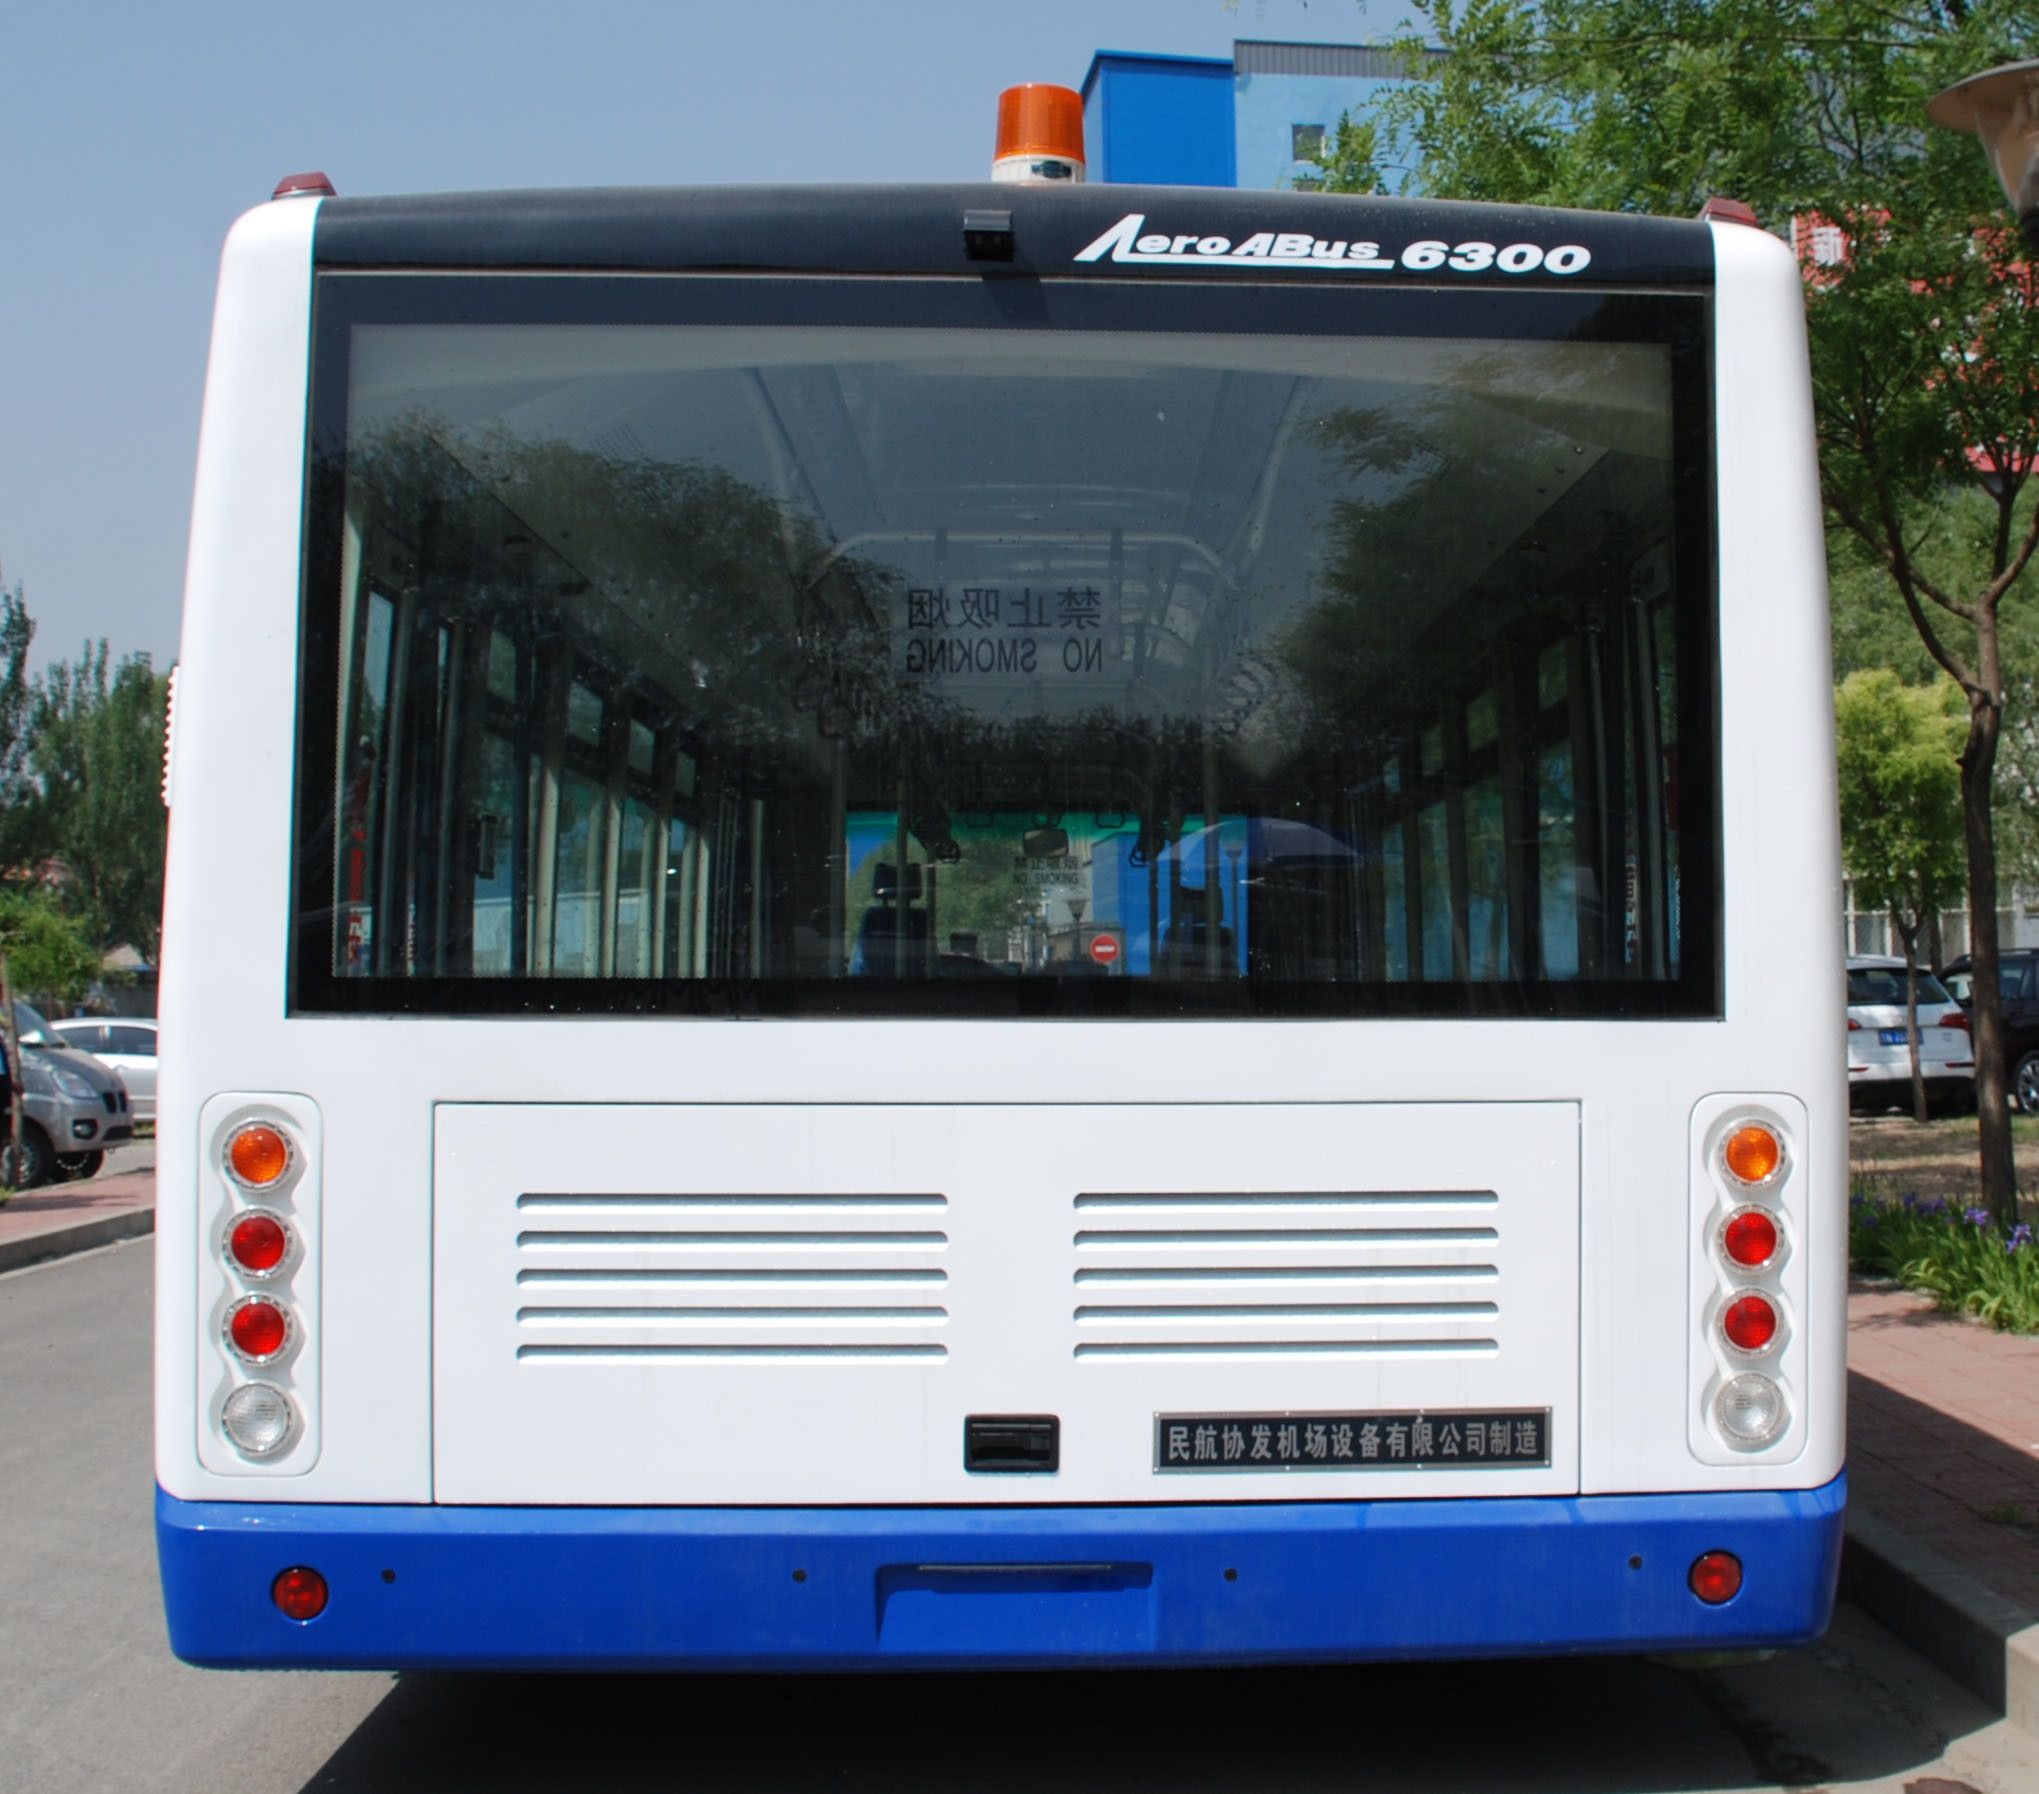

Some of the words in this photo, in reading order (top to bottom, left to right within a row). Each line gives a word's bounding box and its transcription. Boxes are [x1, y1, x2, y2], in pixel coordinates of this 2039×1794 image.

[1401, 241, 1592, 275] 6300
[1013, 872, 1028, 885] NO
[1034, 872, 1079, 885] SMOKING
[1167, 1419, 1539, 1461] 民航协发机场设备有限公司制造
